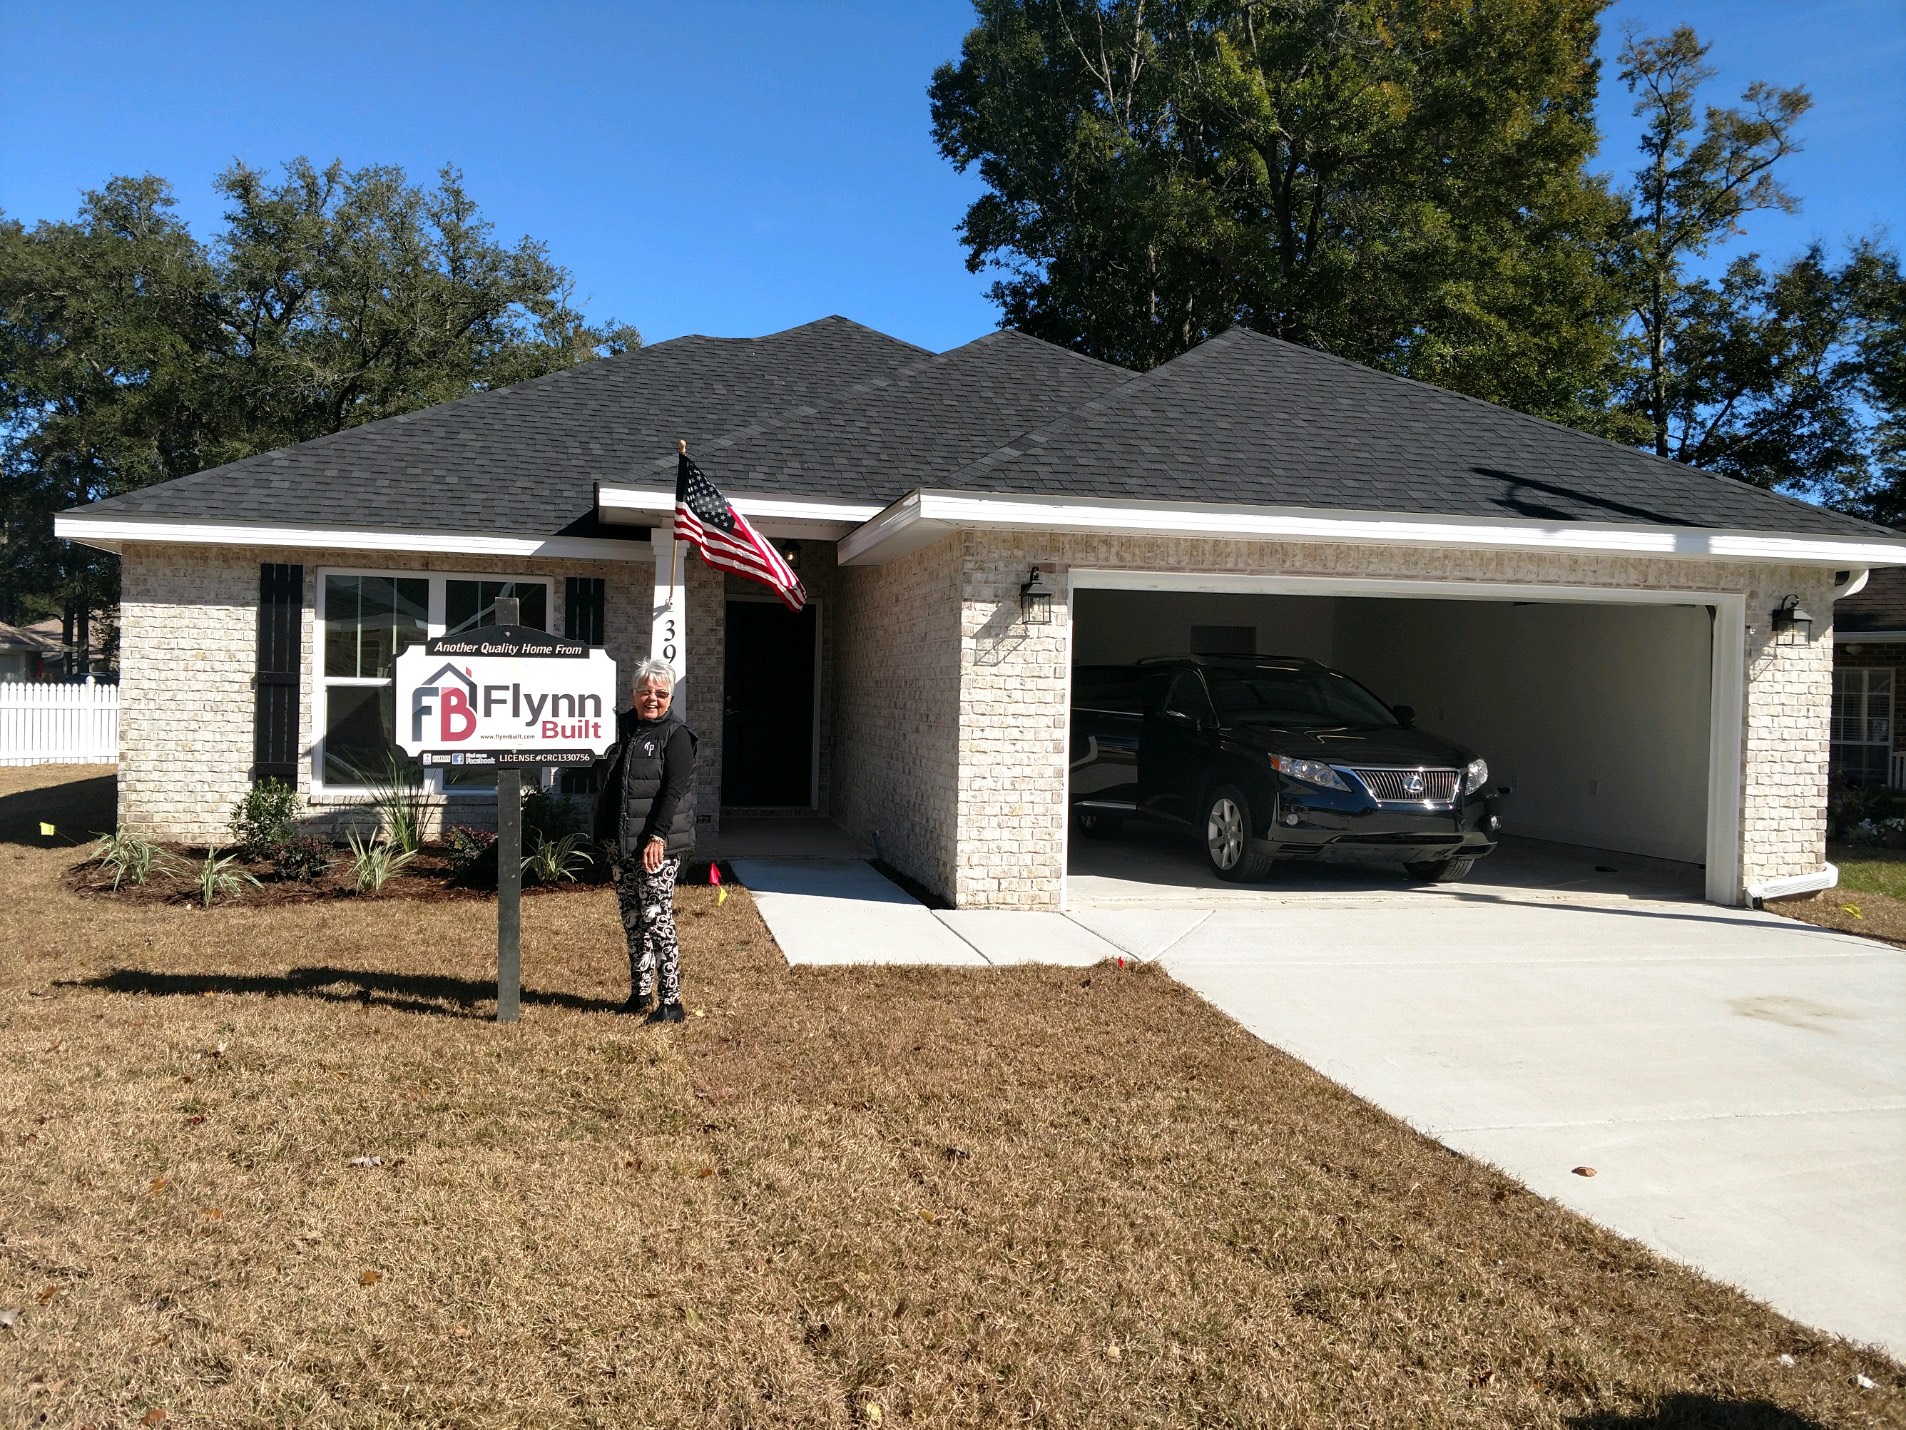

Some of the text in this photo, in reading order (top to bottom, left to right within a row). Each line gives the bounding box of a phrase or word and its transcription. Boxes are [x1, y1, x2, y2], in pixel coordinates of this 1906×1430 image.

[434, 641, 582, 656] Another Quality Home From
[412, 687, 477, 742] FB
[484, 683, 602, 727] Flynn
[542, 719, 602, 739] Built
